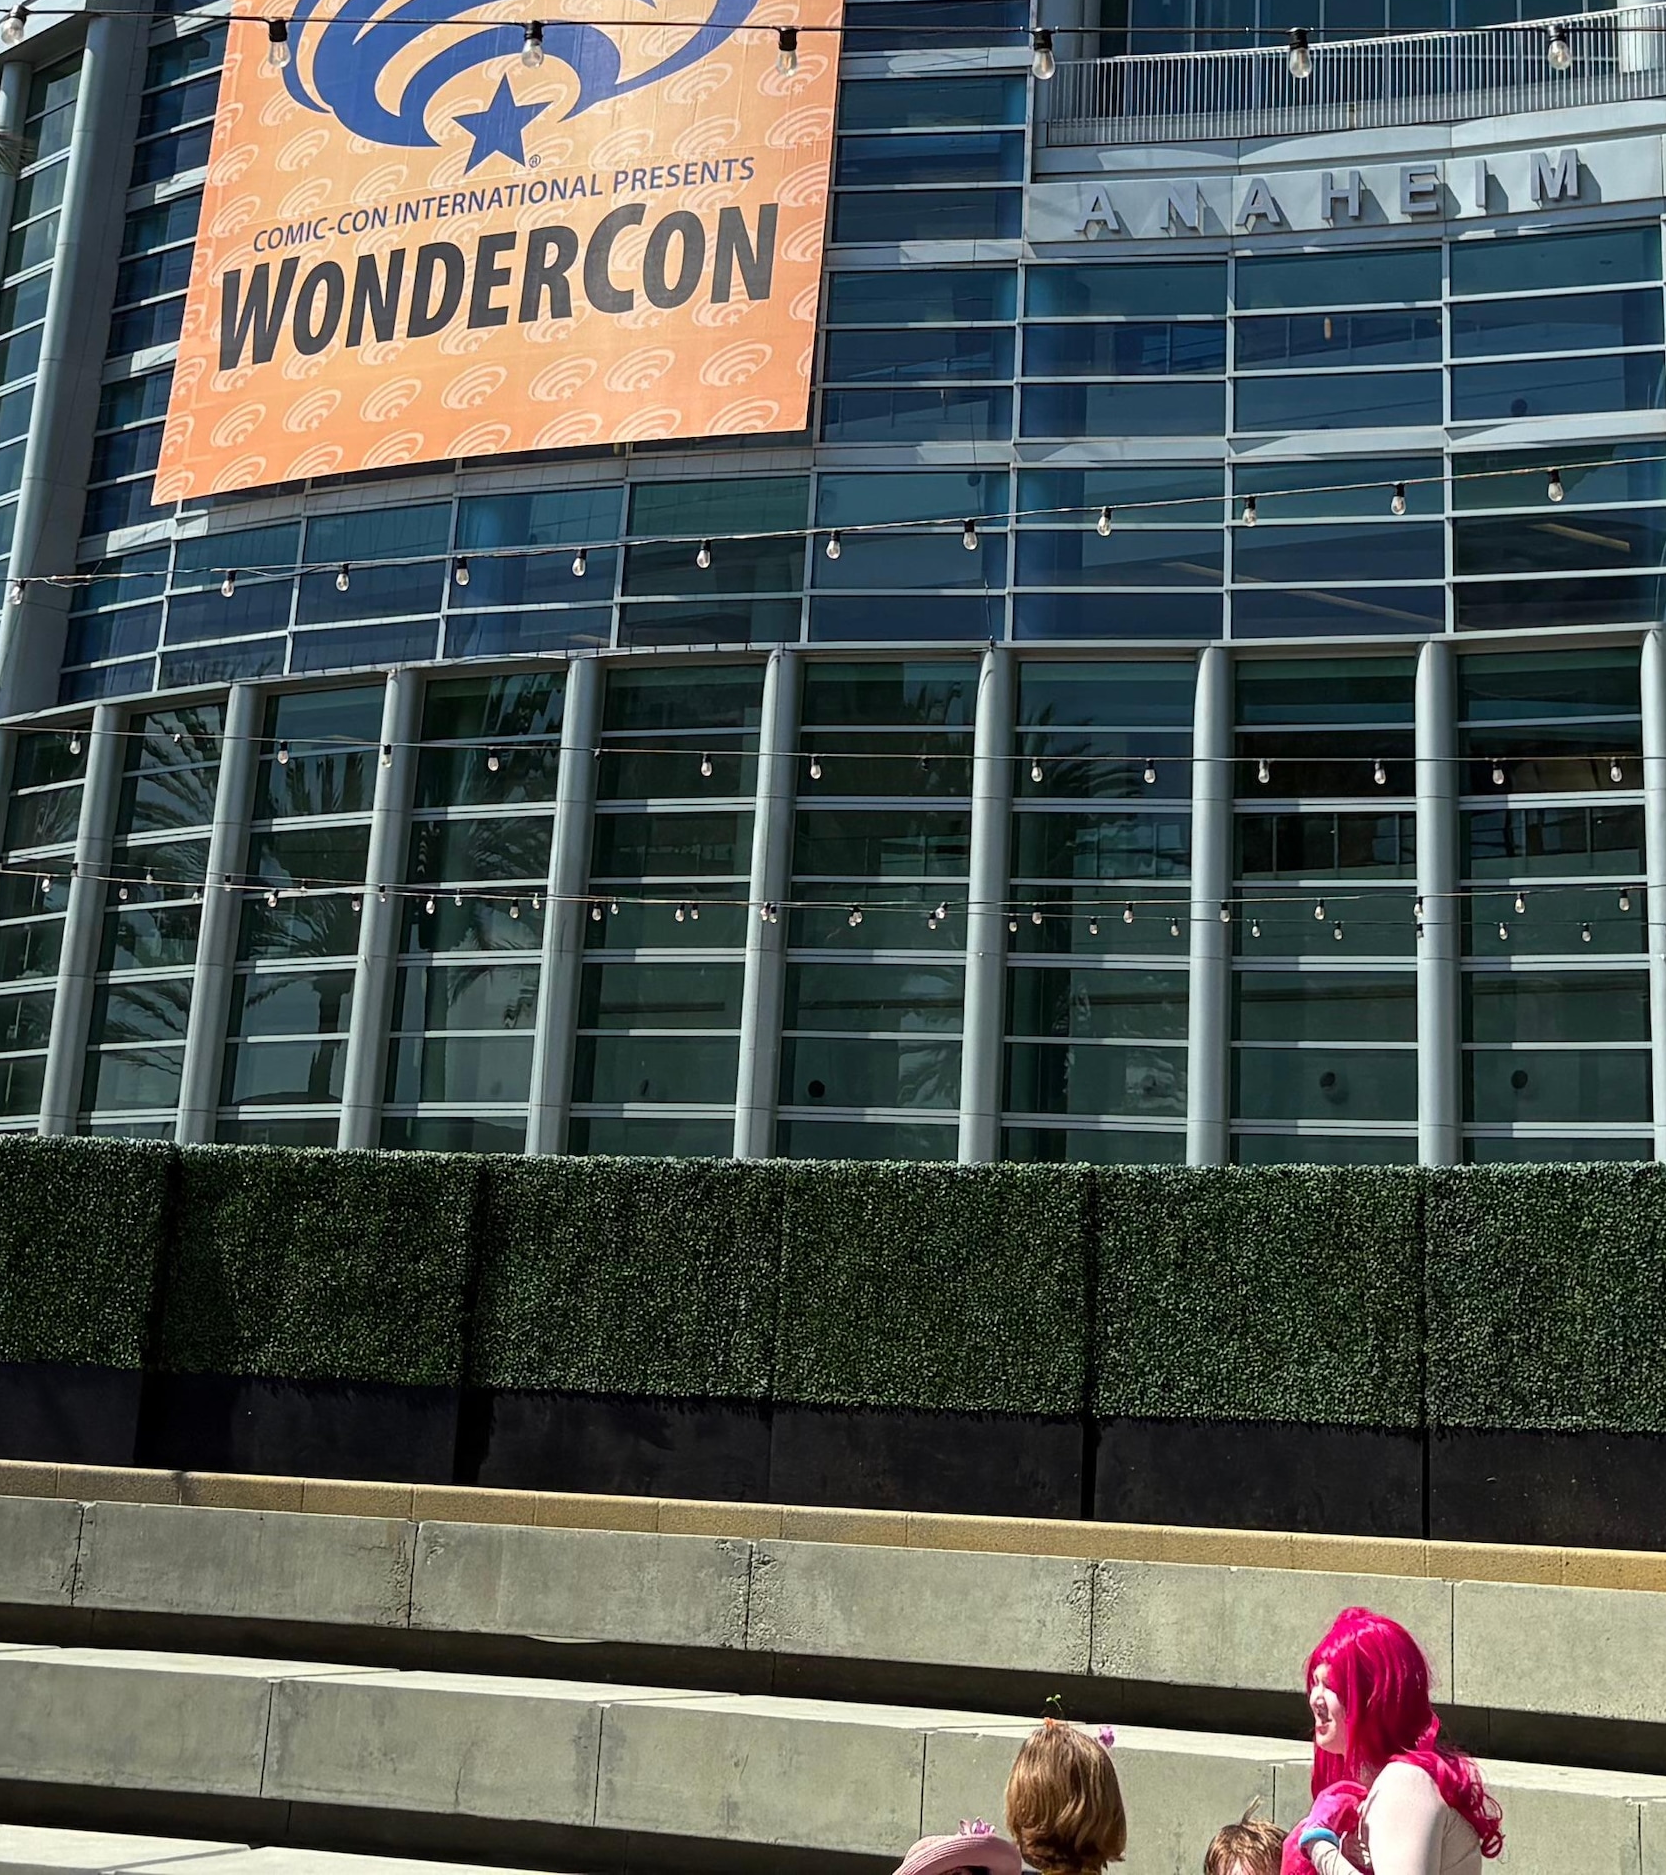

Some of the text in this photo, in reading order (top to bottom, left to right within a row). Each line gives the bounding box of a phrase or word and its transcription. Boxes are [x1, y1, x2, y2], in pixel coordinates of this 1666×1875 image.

[252, 155, 756, 253] COMIC-CON INTERNATIONAL PRESENTS
[1074, 148, 1580, 232] ANAHEIM
[218, 202, 779, 372] WONDERCON
